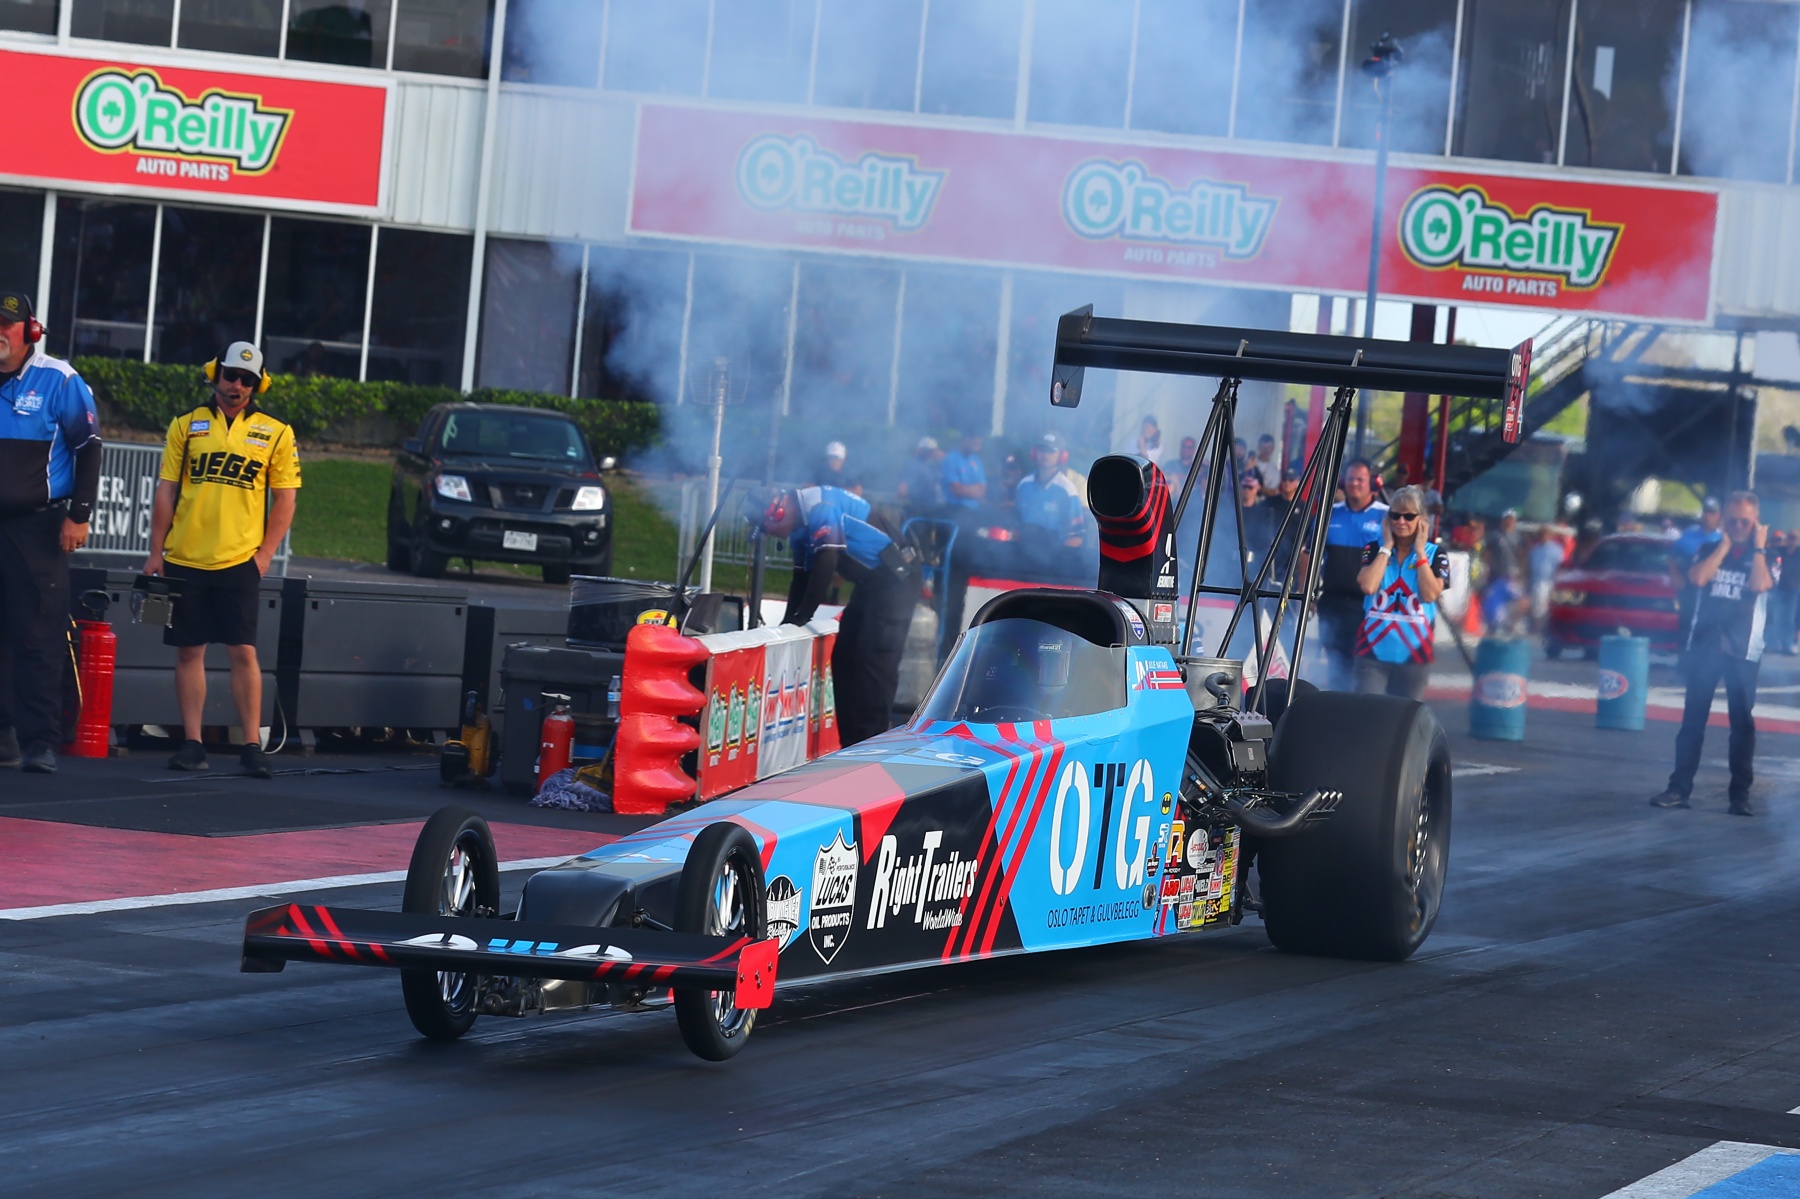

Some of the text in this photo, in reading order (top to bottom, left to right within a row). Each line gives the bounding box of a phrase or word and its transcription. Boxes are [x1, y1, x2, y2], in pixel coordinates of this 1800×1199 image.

[86, 80, 275, 162] O'Reilly
[136, 157, 229, 181] AUTO PARTS
[745, 142, 932, 223] O'Reilly
[1072, 168, 1264, 249] O'Reilly
[1411, 197, 1606, 278] O'Reilly
[1123, 247, 1216, 269] AUTO PARTS
[1462, 274, 1557, 297] AUTO PARTS
[190, 451, 264, 483] JEGS
[97, 475, 131, 508] ER,
[1050, 758, 1154, 896] OTG
[815, 874, 853, 906] LUCAS
[811, 912, 850, 930] OIL PRODUCTS
[1047, 900, 1140, 929] OSLO TAPET & GULVBELEGG
[823, 934, 835, 949] INC.
